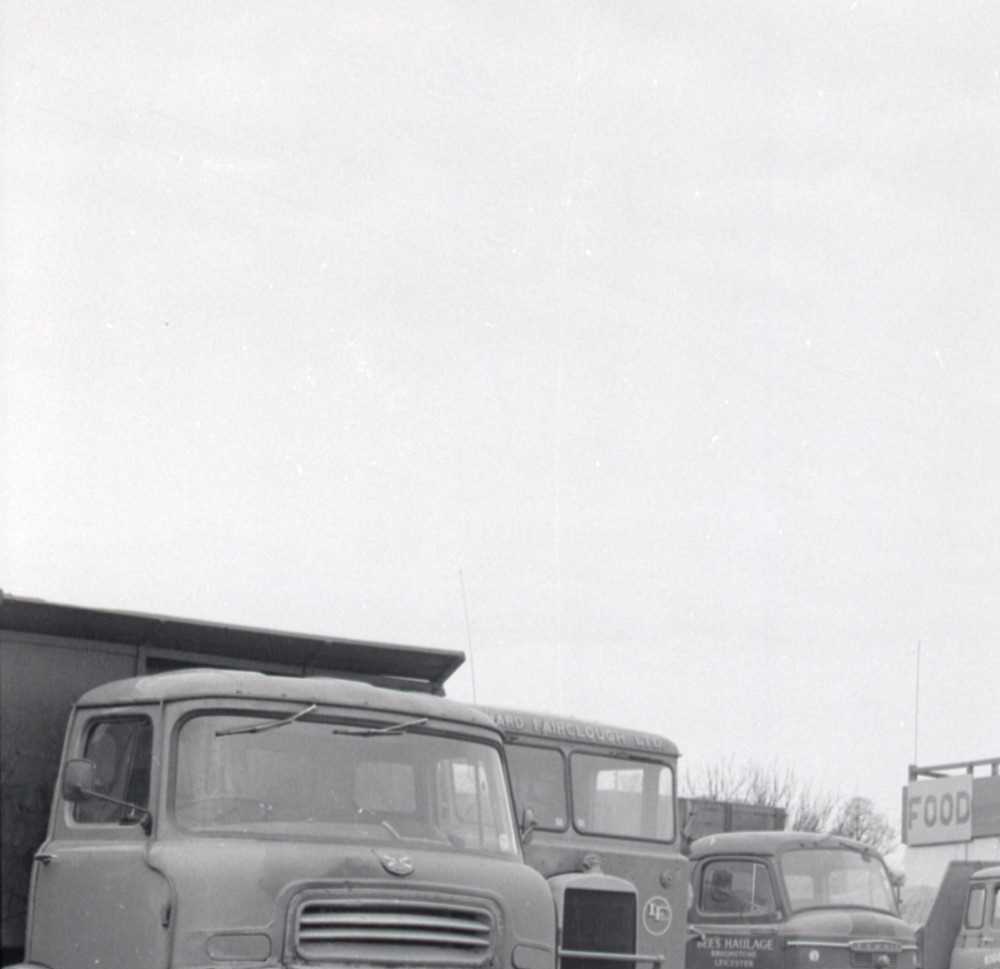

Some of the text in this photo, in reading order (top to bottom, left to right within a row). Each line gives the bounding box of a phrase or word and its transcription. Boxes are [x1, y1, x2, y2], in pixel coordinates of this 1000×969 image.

[532, 718, 626, 746] FAIRCLOUGH
[908, 790, 970, 829] FOOD
[724, 937, 774, 951] HAULAGE
